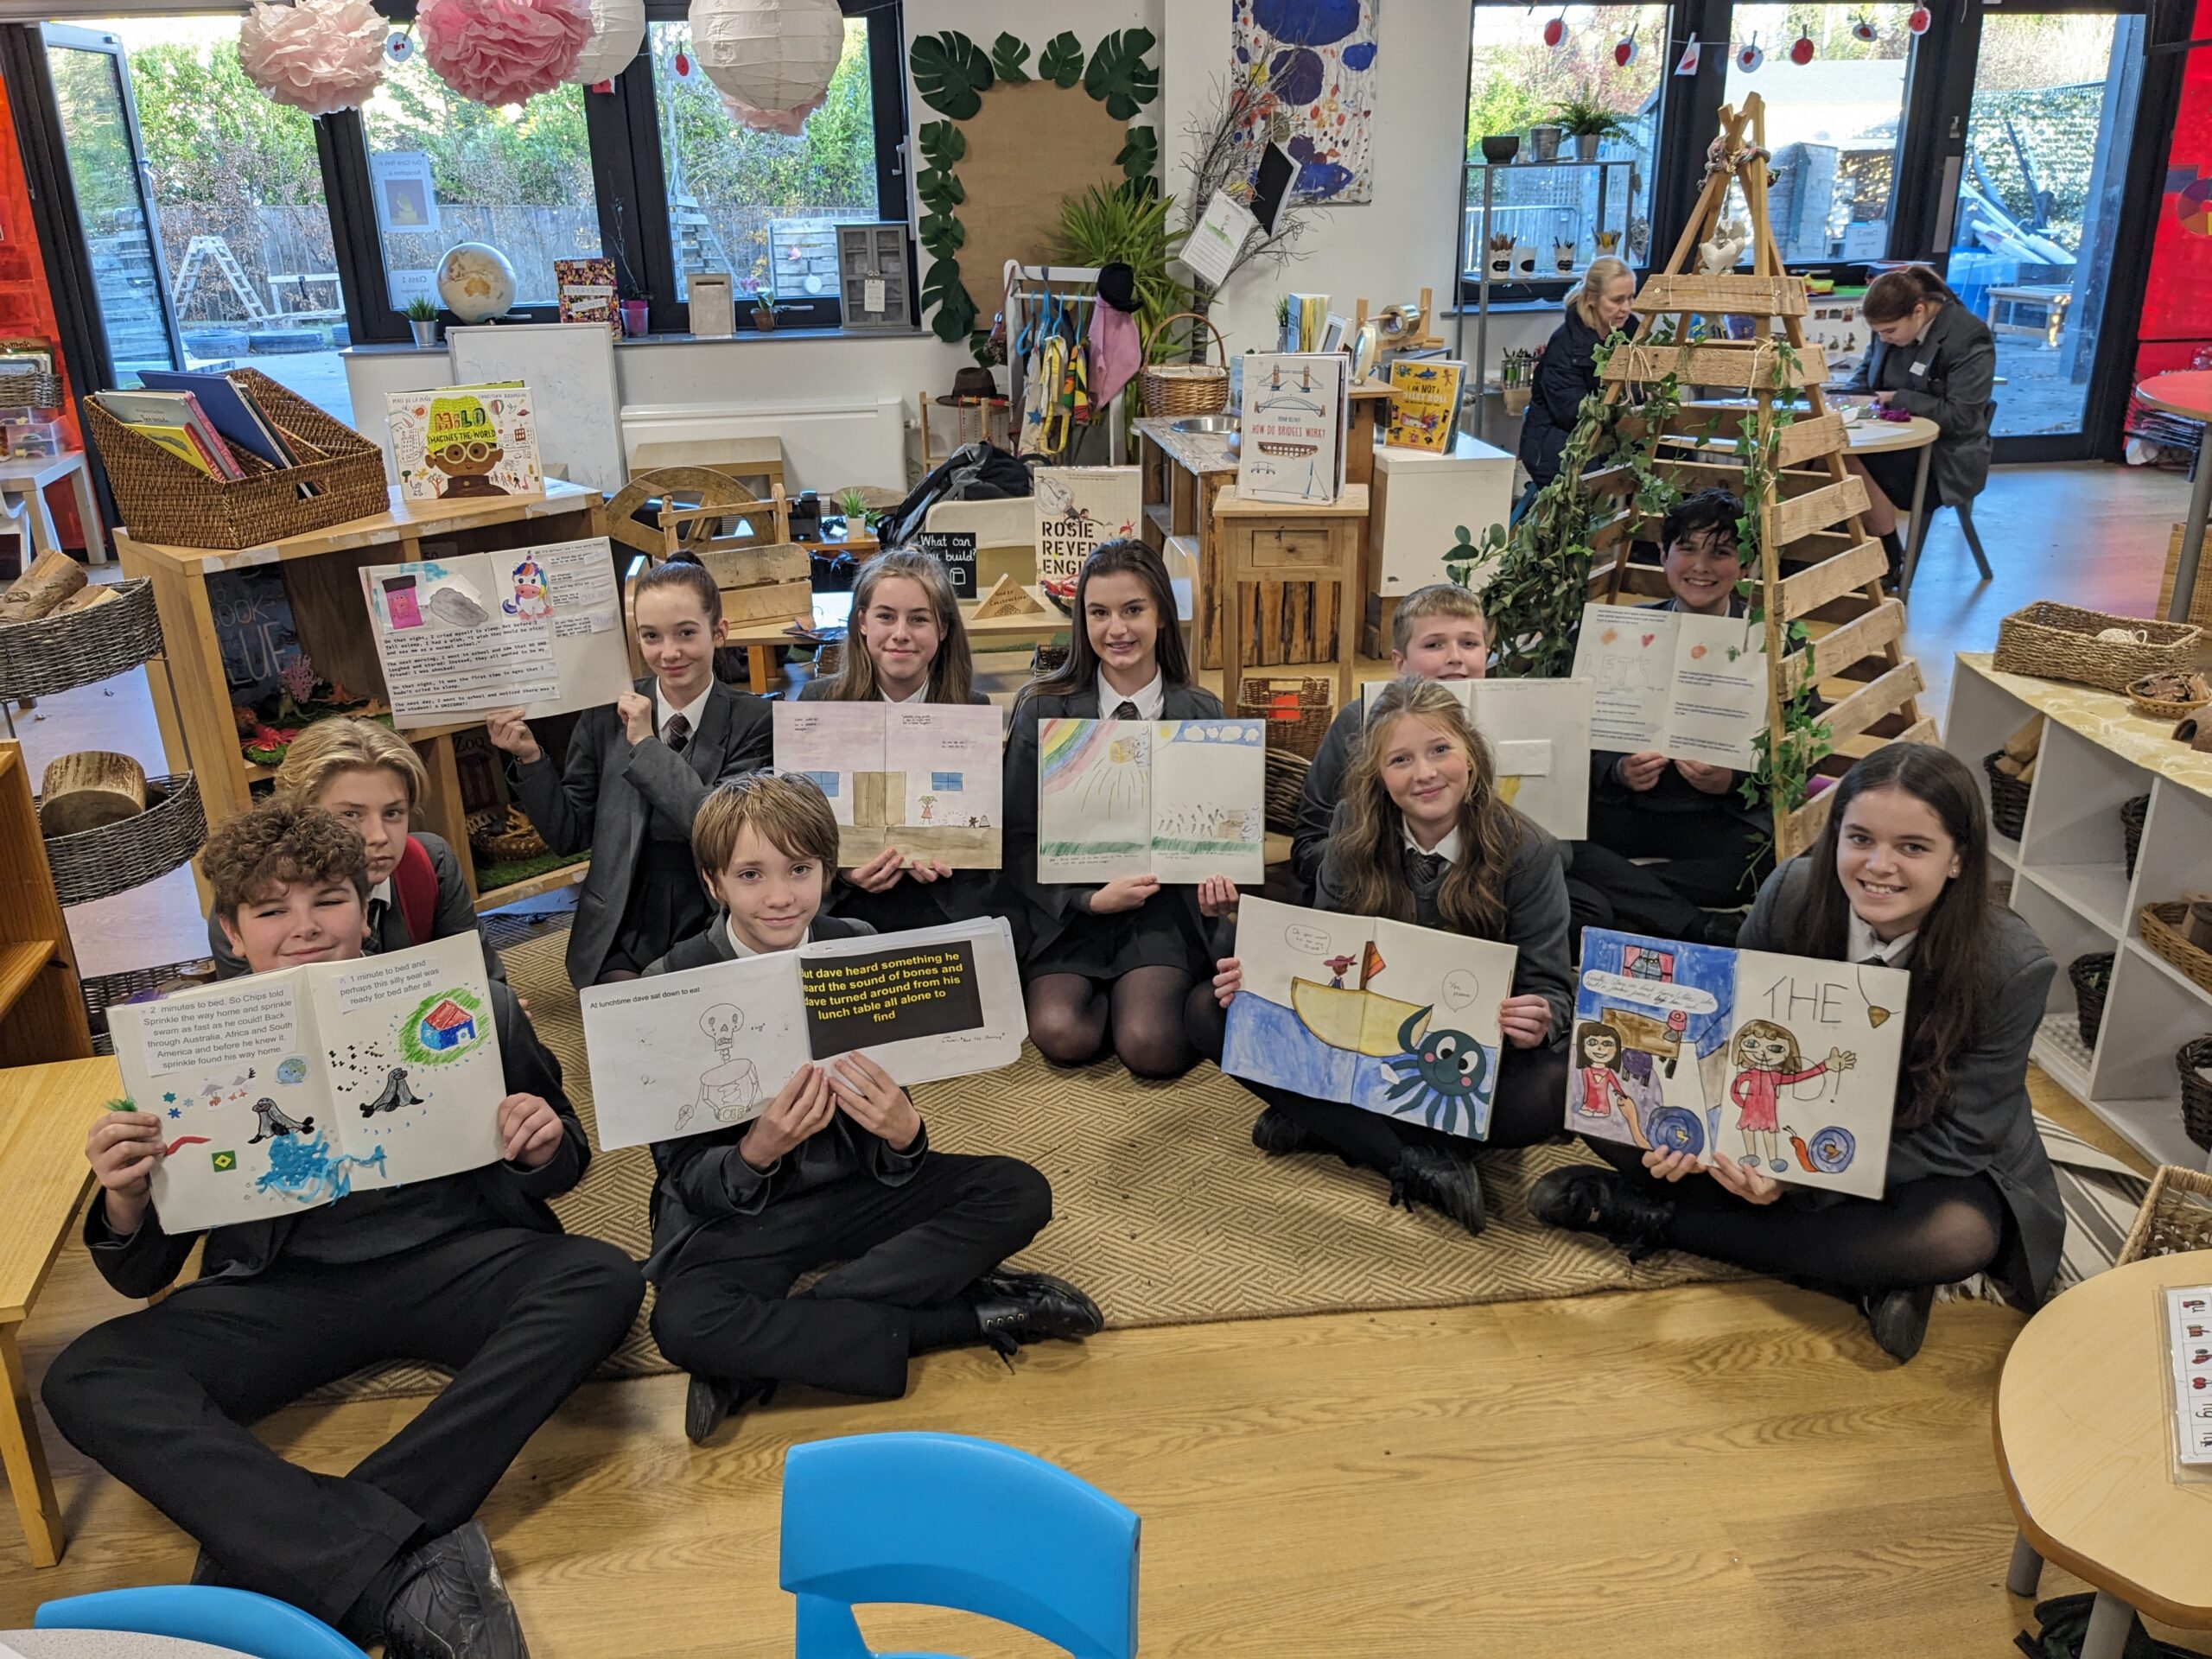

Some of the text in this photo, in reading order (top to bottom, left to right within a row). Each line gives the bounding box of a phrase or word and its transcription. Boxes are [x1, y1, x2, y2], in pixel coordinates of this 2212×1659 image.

[575, 301, 603, 309] COUNTS
[1422, 385, 1436, 394] NOT
[429, 429, 496, 444] IMAGINES THE WORLD
[1252, 425, 1325, 439] HOW DO BRIDGES WORK?
[920, 535, 971, 547] What can
[1042, 522, 1094, 537] ROSIE
[925, 548, 976, 562] ou build?
[356, 969, 384, 981] minute
[394, 963, 409, 972] bed
[411, 960, 426, 969] and
[815, 965, 842, 979] dave
[845, 962, 878, 976] heard
[880, 951, 942, 972] something
[944, 950, 959, 962] he
[340, 968, 439, 996] perhaps this silly seal was
[803, 963, 963, 994] eard the sound of bones and
[830, 990, 867, 1005] turned
[869, 982, 910, 998] around
[912, 976, 940, 989] from
[943, 974, 960, 985] his
[160, 1002, 194, 1013] minutes
[242, 992, 267, 1003] Chips
[268, 989, 283, 998] told
[349, 994, 372, 1006] ready
[374, 990, 385, 999] for
[386, 987, 401, 996] bed
[403, 982, 420, 992] after
[598, 997, 631, 1007] lunchtime
[817, 988, 945, 1020] lunch table all alone to
[1763, 976, 1849, 1023] THE
[143, 1014, 179, 1027] Sprinkle
[197, 1011, 214, 1020] way
[216, 1007, 240, 1017] home
[242, 1004, 258, 1013] and
[259, 999, 292, 1011] sprinkle
[153, 1027, 179, 1037] swam
[194, 1022, 210, 1031] fast
[237, 1015, 263, 1026] could!
[264, 1011, 284, 1020] Back
[873, 1010, 896, 1024] find
[147, 1036, 181, 1050] through
[224, 1028, 249, 1039] Africa
[250, 1025, 267, 1034] and
[268, 1020, 293, 1032] South
[156, 1046, 192, 1058] America
[194, 1044, 210, 1053] and
[213, 1040, 239, 1051] before
[254, 1035, 276, 1045] knew
[162, 1057, 195, 1070] sprinkle
[197, 1053, 222, 1065] found
[223, 1052, 237, 1060] his
[238, 1050, 256, 1059] way
